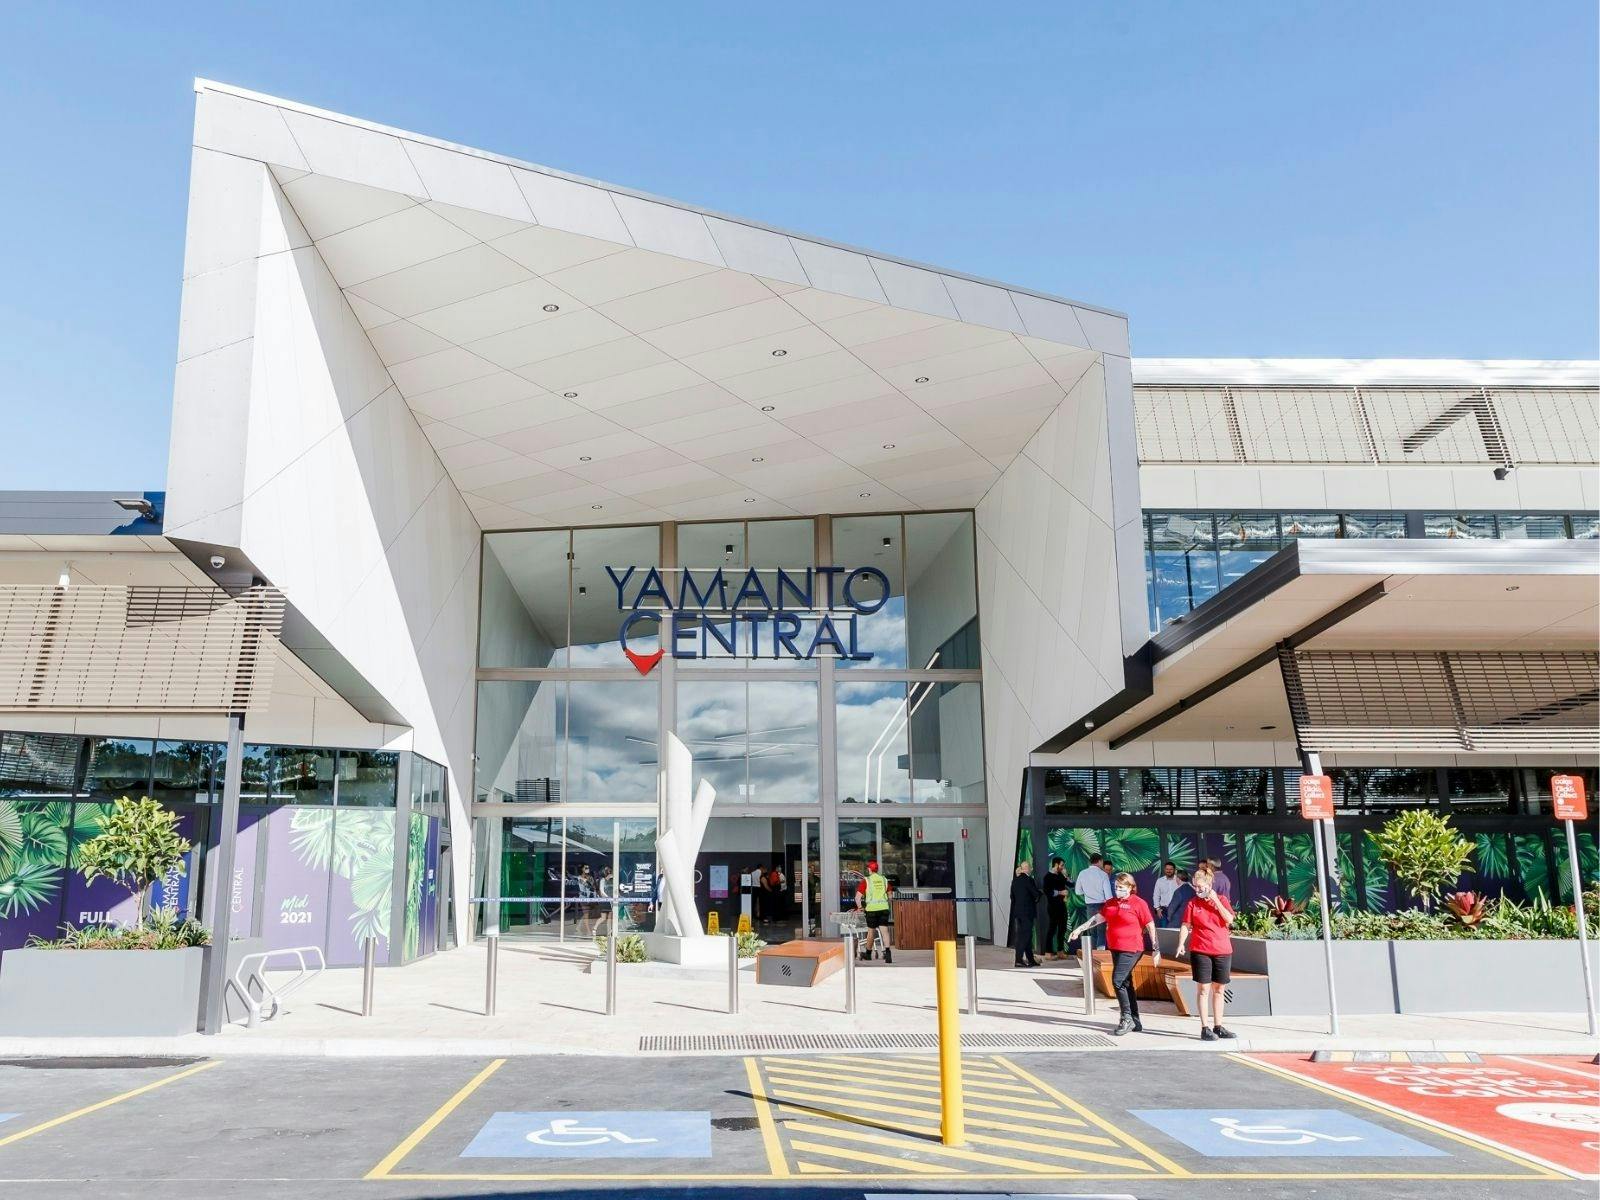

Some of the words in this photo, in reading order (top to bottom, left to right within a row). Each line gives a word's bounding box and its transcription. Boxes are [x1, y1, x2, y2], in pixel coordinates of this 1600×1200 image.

[605, 565, 891, 614] YAMANTO
[619, 610, 875, 676] CENTRAL
[230, 866, 244, 912] CENTRAL
[280, 894, 308, 911] Mid
[79, 911, 113, 924] FULL
[280, 911, 312, 924] 2021
